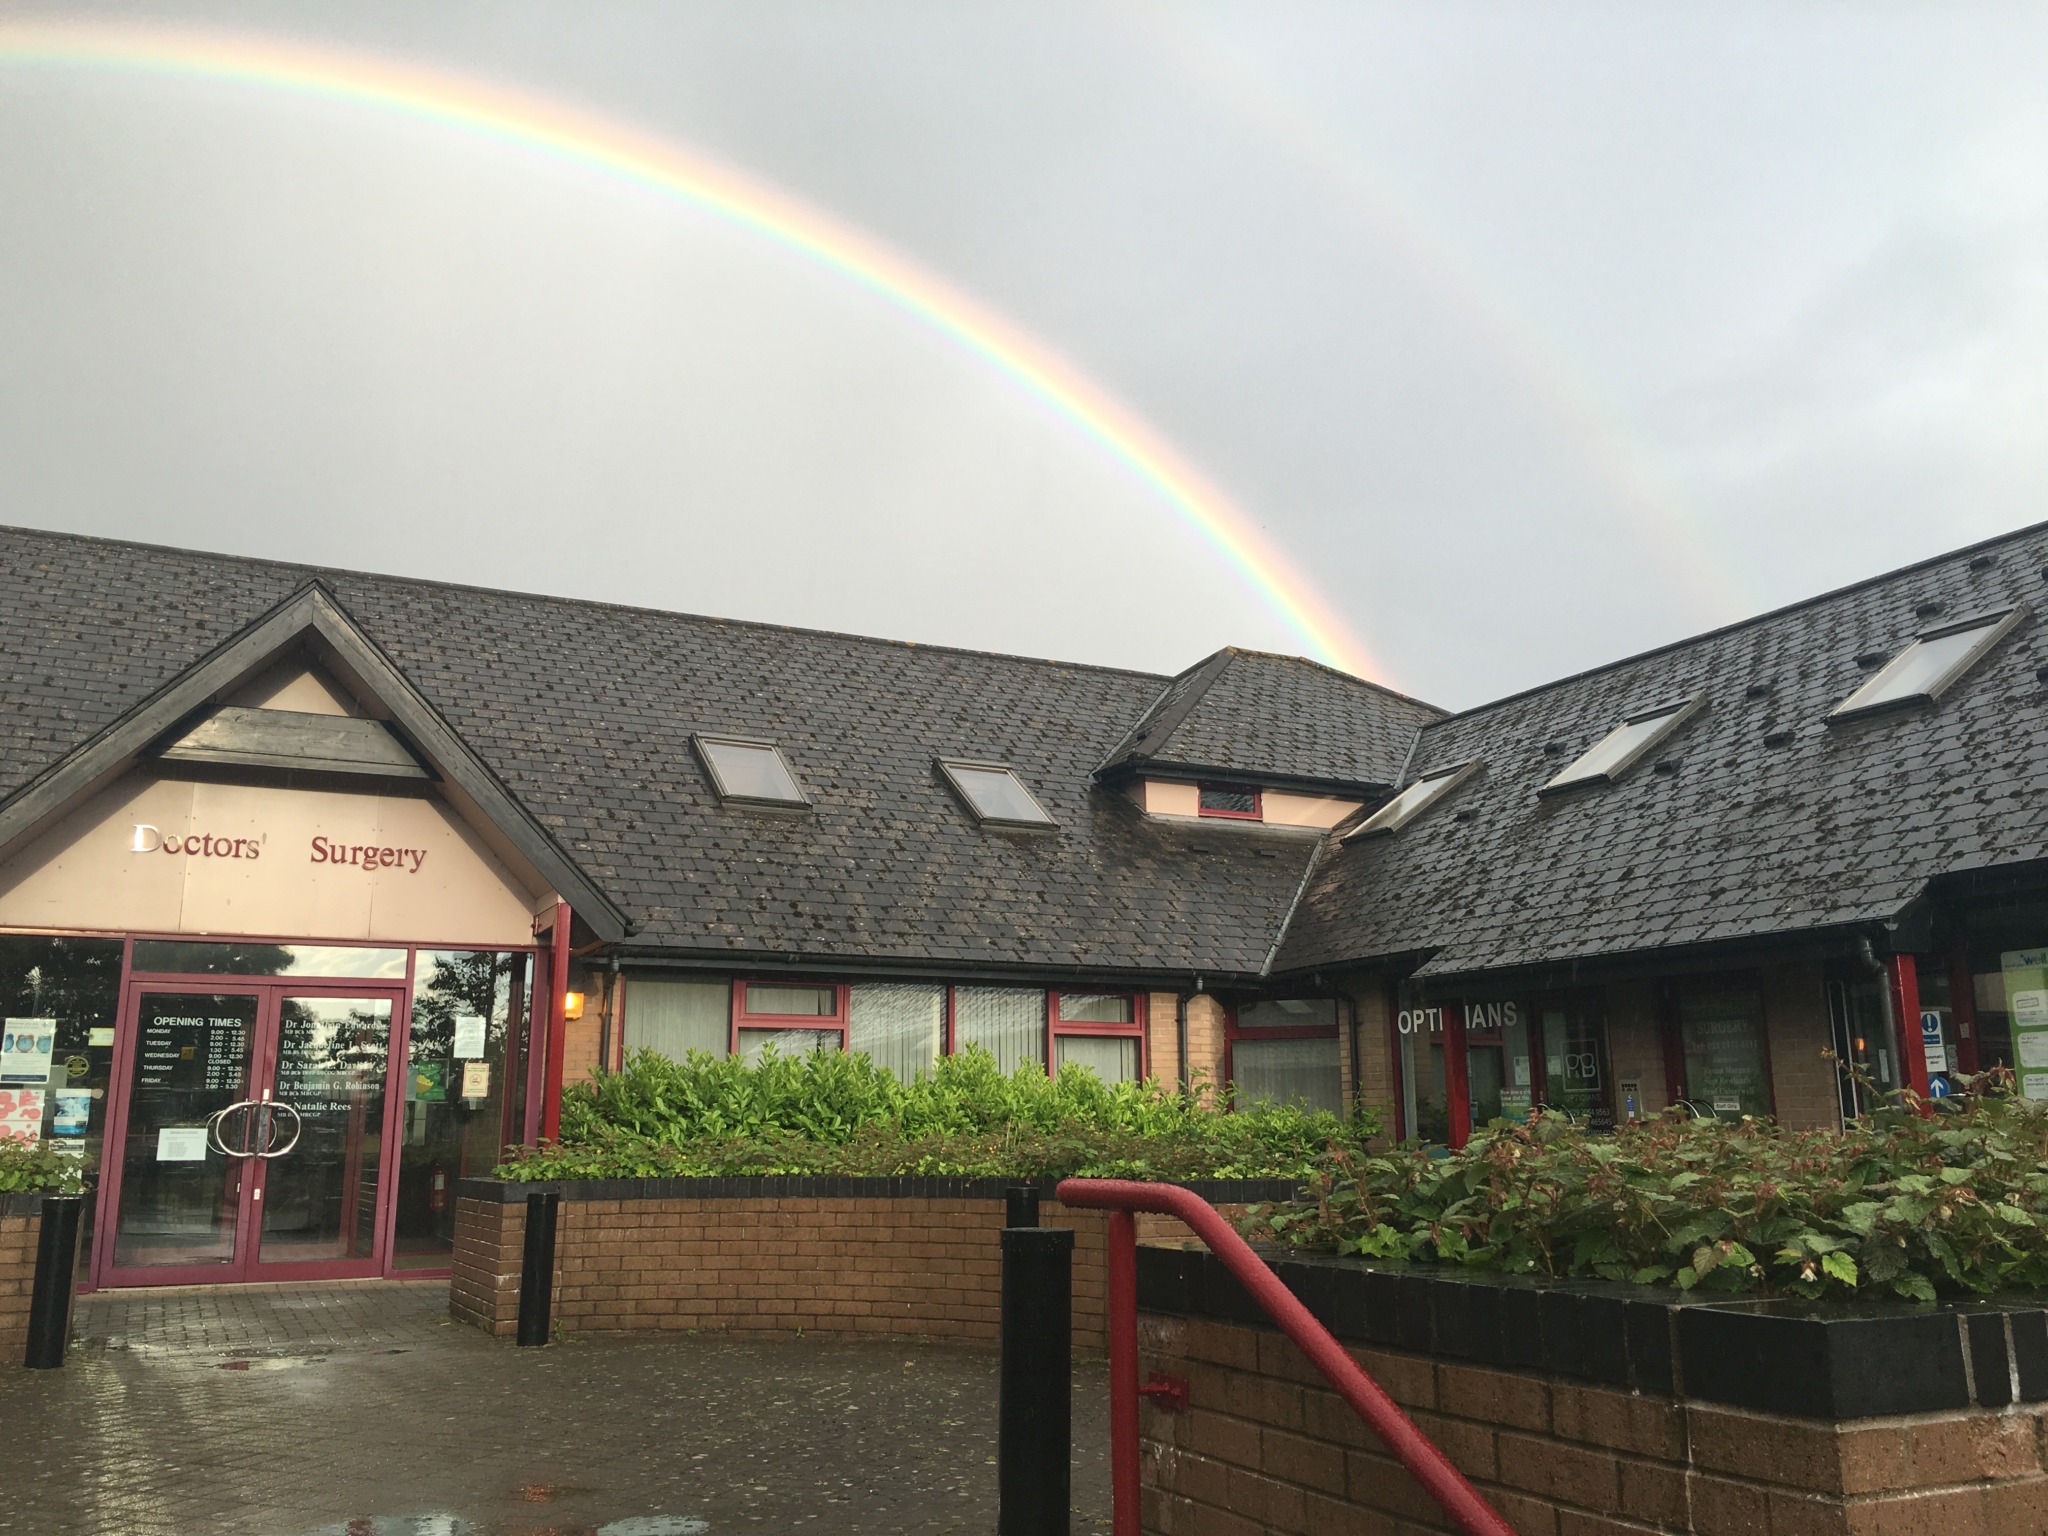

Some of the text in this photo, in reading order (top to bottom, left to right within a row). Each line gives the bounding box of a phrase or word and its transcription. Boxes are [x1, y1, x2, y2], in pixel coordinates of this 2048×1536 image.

[130, 824, 427, 873] Doctors' Surgery
[154, 1017, 242, 1027] OPENING TIMES
[1397, 1001, 1518, 1034] OPTIIANS
[285, 1020, 297, 1028] Dr
[1696, 1019, 1748, 1034] SURGERY
[283, 1040, 295, 1049] Dr
[282, 1061, 294, 1069] Dr
[280, 1081, 380, 1091] Dr Benjamin G. Robinson
[294, 1102, 327, 1110] Natalie
[330, 1102, 352, 1110] Rees
[1596, 1108, 1610, 1116] 9563
